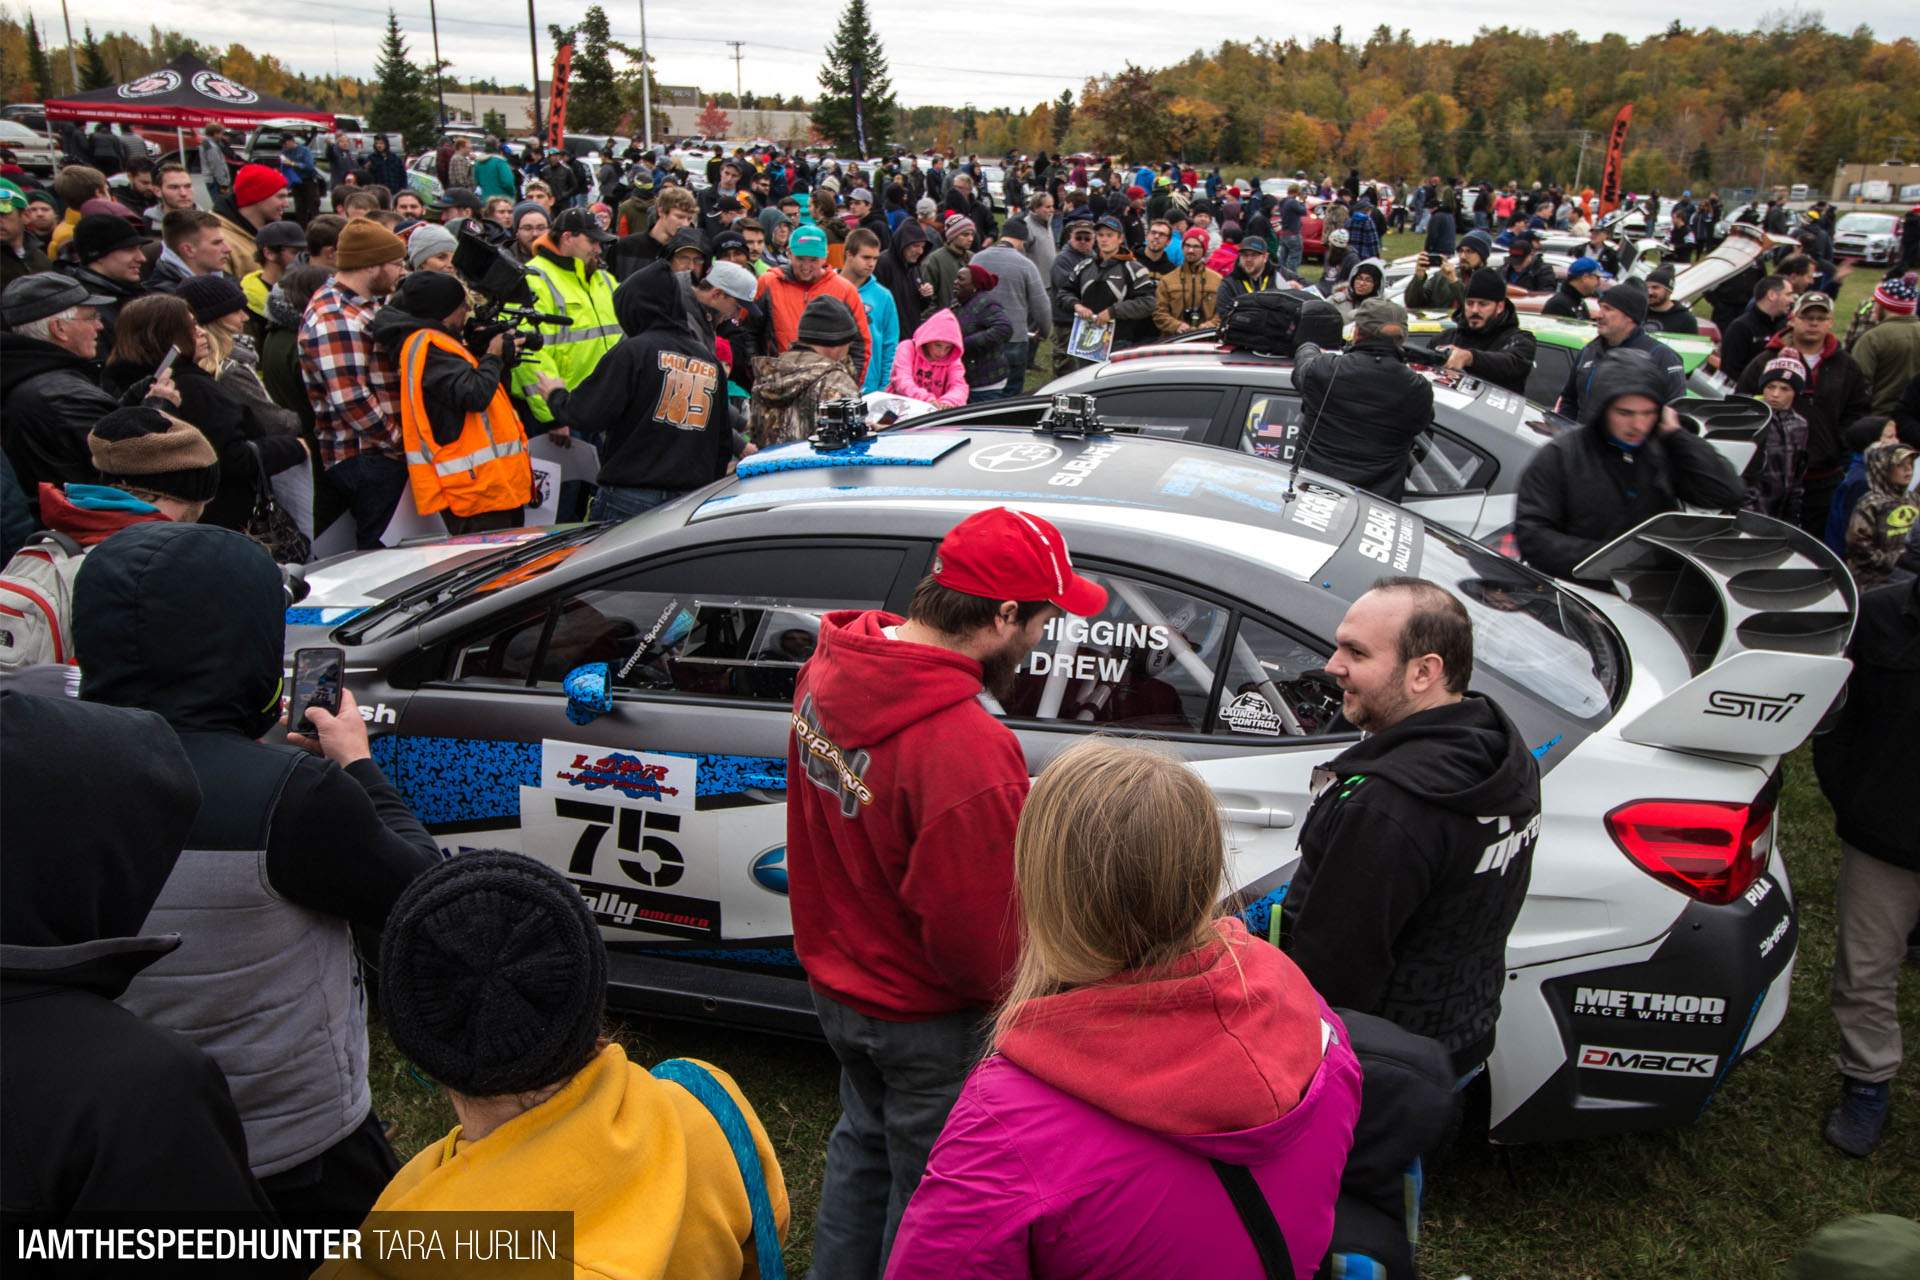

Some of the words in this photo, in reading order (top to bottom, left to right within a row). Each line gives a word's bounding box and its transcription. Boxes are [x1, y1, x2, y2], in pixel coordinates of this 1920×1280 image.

[660, 352, 717, 381] MULDER
[1291, 484, 1342, 533] HIGGINS
[1358, 504, 1397, 564] SUBARU
[617, 641, 648, 679] Vermont
[643, 598, 679, 644] SportsCar
[1029, 651, 1129, 683] DREW
[1220, 706, 1261, 720] LAUNCH
[1230, 717, 1279, 730] CONTROL
[554, 797, 685, 888] 75
[571, 883, 639, 925] ally
[638, 908, 710, 929] AMERICA
[1744, 877, 1773, 908] PIAA
[1574, 1004, 1626, 1018] RACE
[1637, 1010, 1723, 1024] WHEELS
[1575, 986, 1726, 1016] METHOD
